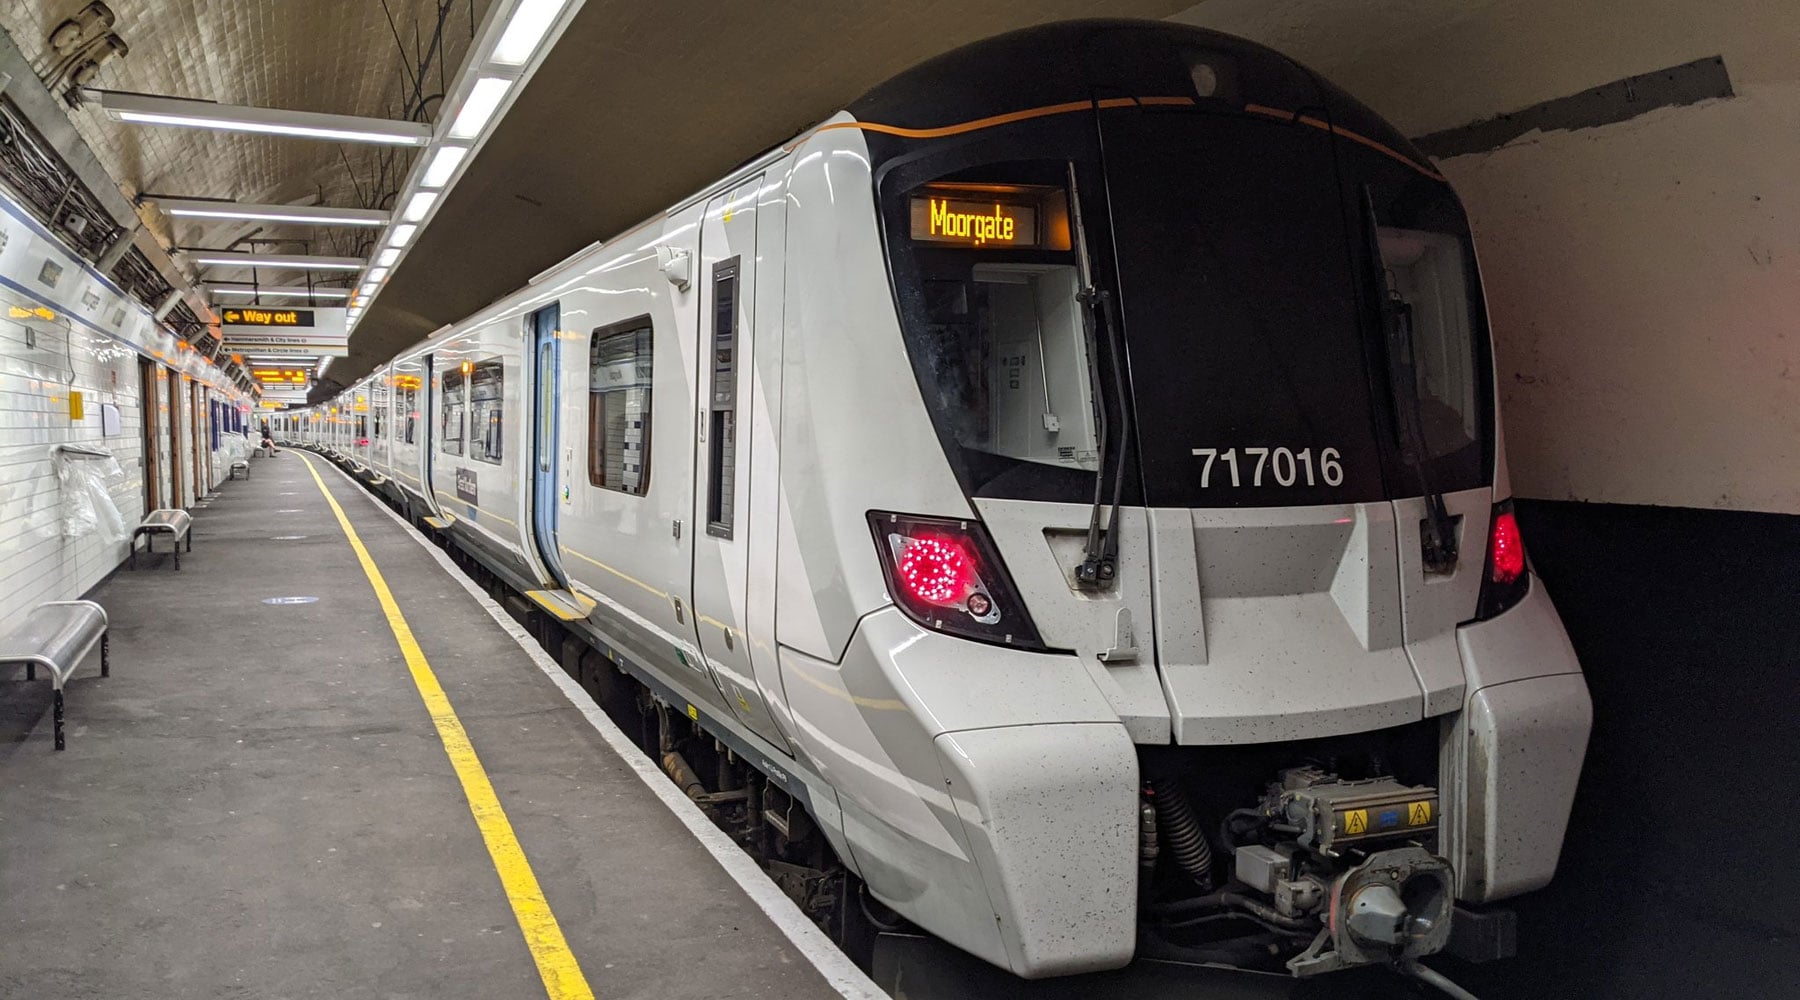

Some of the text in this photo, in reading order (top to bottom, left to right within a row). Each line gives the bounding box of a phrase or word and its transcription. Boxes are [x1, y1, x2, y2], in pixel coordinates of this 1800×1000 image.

[930, 199, 1014, 245] Moorgate
[243, 310, 297, 324] Way out
[1192, 447, 1344, 488] 717016
